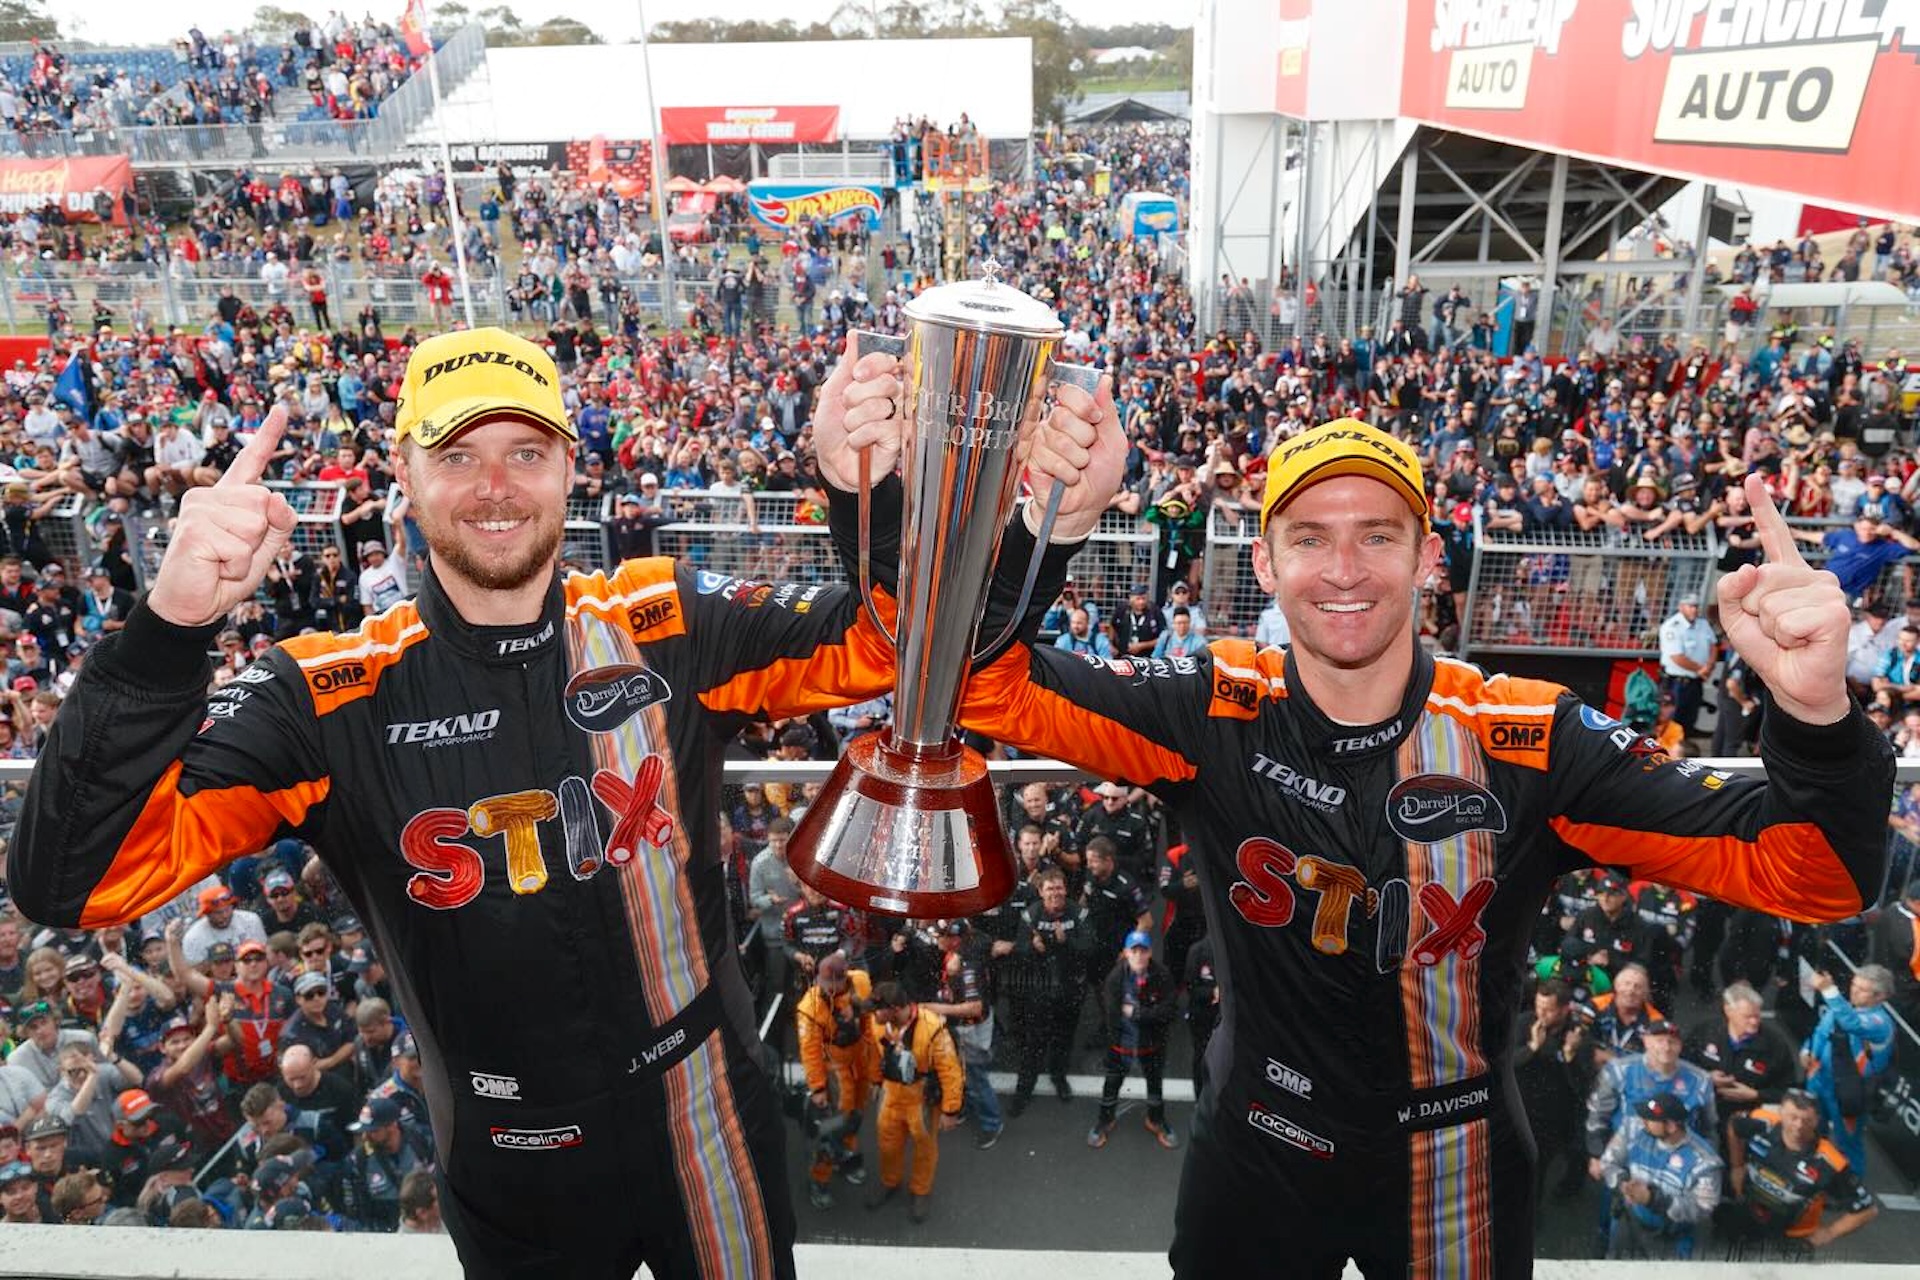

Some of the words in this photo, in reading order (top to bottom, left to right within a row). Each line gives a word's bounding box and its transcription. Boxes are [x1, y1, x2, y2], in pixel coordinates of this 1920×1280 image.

[1457, 59, 1518, 93] AUTO
[1679, 66, 1834, 123] AUTO
[478, 145, 549, 161] BATHURST!
[819, 189, 875, 216] WHEELS
[422, 351, 549, 387] DUNLOP
[1281, 430, 1410, 468] DUNLOP
[629, 600, 674, 630] OMP
[496, 620, 555, 656] TEKNO
[312, 666, 367, 690] OMP
[577, 681, 620, 711] Darrell
[619, 678, 650, 700] Lea
[1217, 680, 1258, 710] OMP
[386, 709, 500, 744] TEKNO
[422, 730, 496, 750] PERFORMANCE
[1332, 719, 1403, 753] TEKNO
[1490, 726, 1546, 746] OMP
[1251, 753, 1347, 806] TEKNO
[1400, 795, 1452, 817] Darrell
[1453, 795, 1483, 816] Lea
[400, 752, 673, 910] STIX
[1229, 837, 1498, 974] STIX
[628, 1058, 641, 1074] J.
[641, 1028, 687, 1064] WEBB
[471, 1076, 520, 1097] OMP
[1265, 1063, 1313, 1094] OMP
[1397, 1107, 1416, 1123] W.
[1420, 1087, 1489, 1117] DAVISON
[496, 1132, 575, 1147] raceline
[1253, 1110, 1328, 1151] raceline
